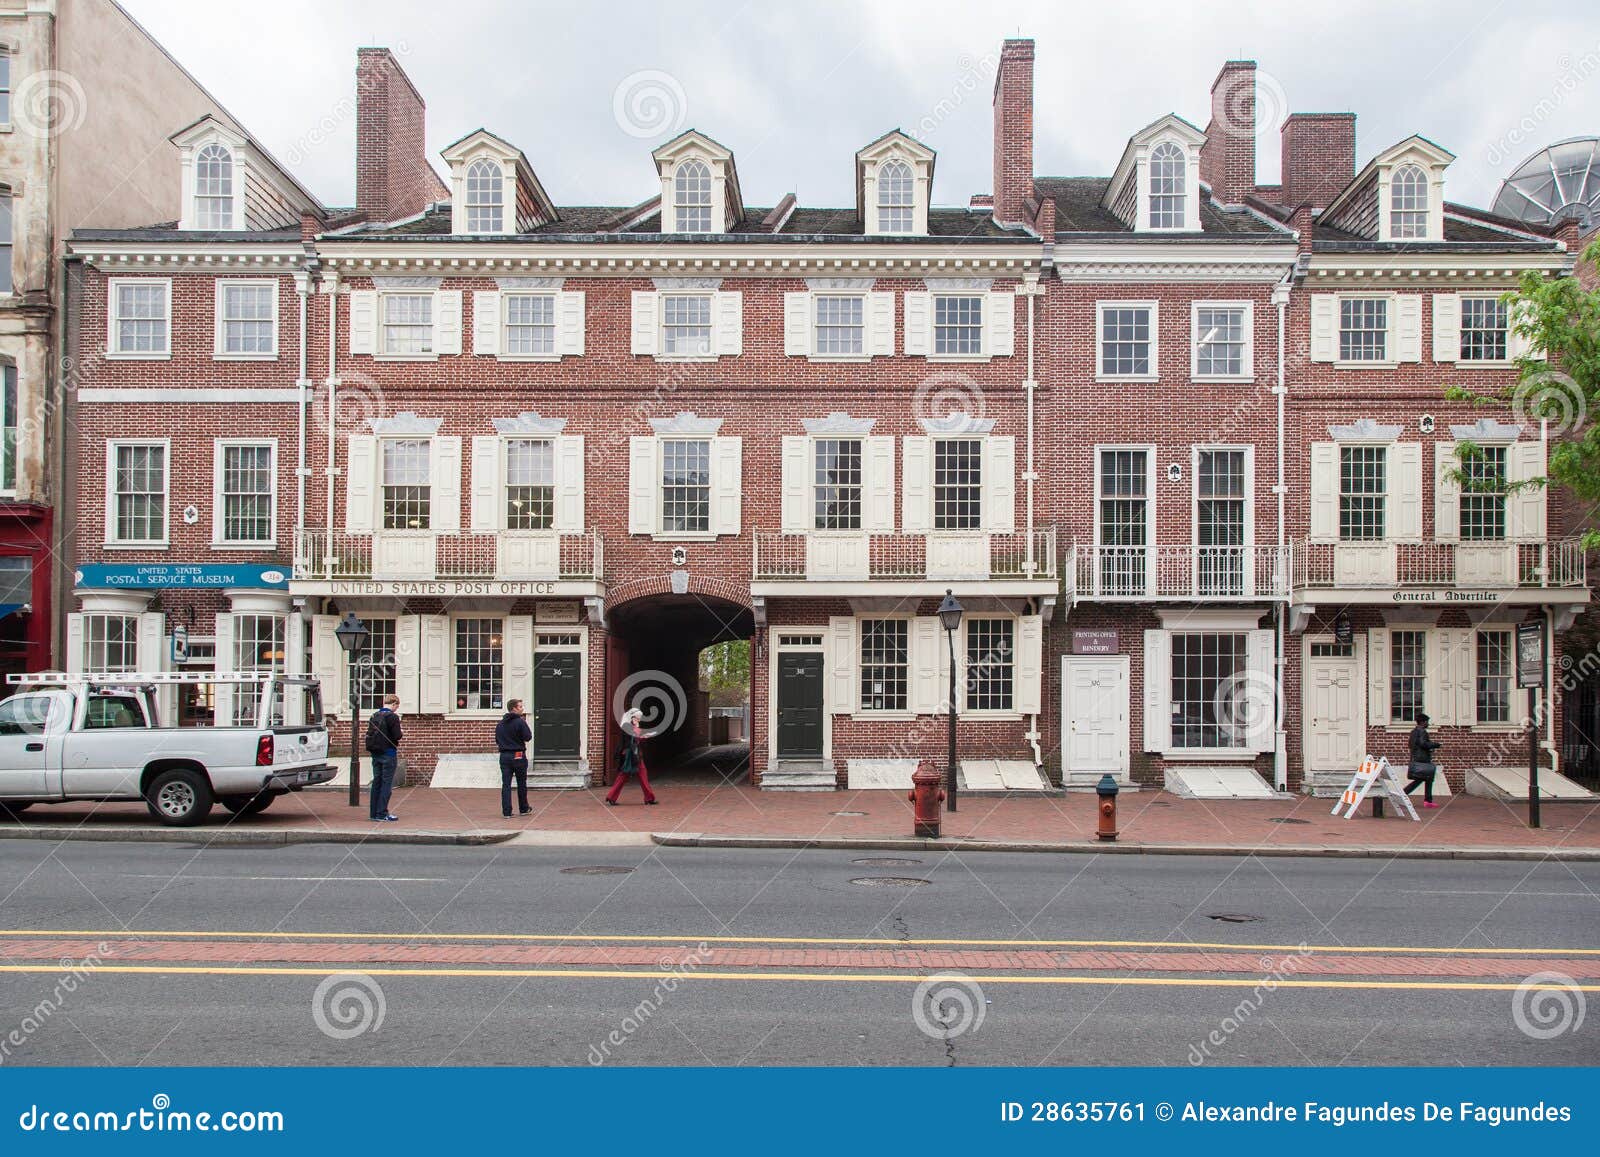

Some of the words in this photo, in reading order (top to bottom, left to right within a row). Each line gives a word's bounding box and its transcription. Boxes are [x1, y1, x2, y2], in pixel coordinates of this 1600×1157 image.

[138, 567, 168, 575] UNITED
[175, 567, 202, 575] STATES
[106, 575, 142, 584] POSTAL
[148, 575, 186, 584] SERVICE
[192, 575, 235, 584] MUSEUM
[331, 582, 384, 594] UNITED
[392, 582, 446, 594] STATES
[454, 582, 492, 594] POST
[500, 582, 555, 594] OFFICE
[1393, 591, 1435, 602] General
